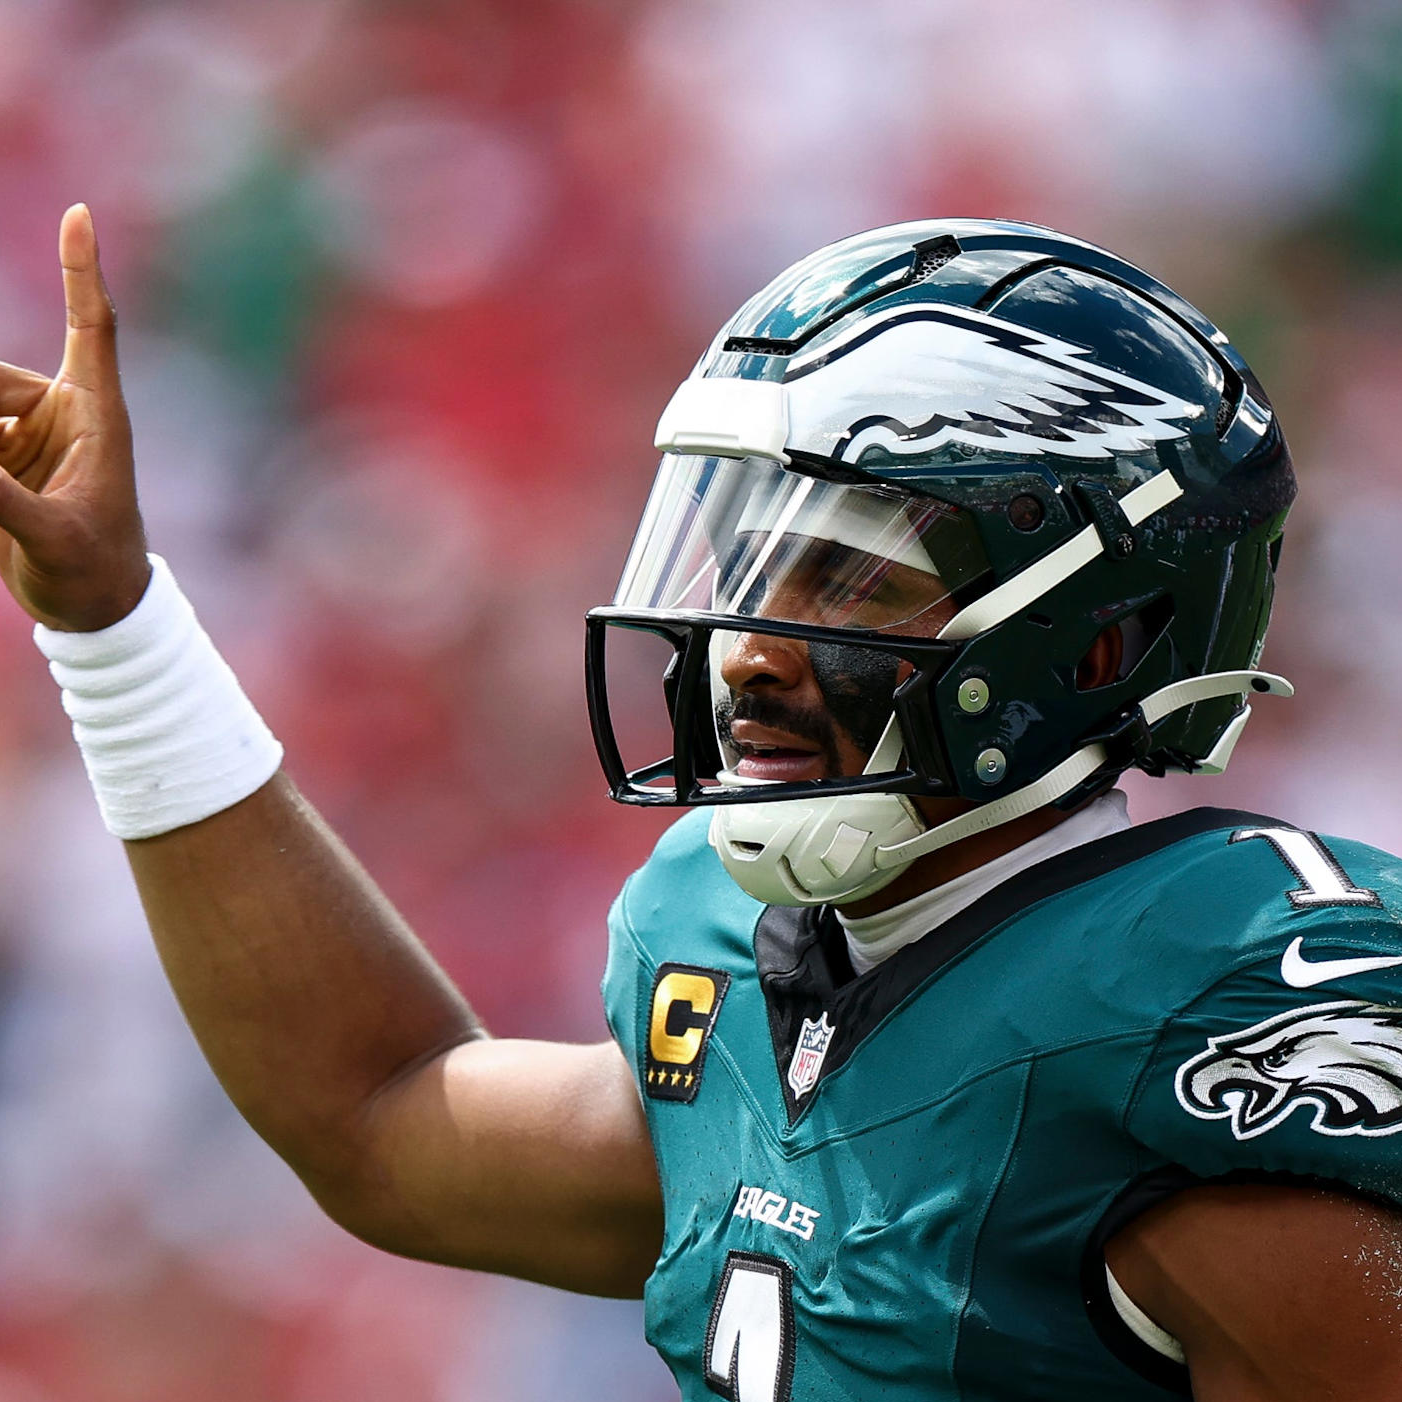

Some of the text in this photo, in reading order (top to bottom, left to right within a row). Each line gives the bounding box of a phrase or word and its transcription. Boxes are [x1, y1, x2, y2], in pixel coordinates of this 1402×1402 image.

[1228, 826, 1383, 909] 1
[650, 972, 716, 1065] C
[795, 1051, 819, 1084] NFL
[733, 1185, 821, 1241] EAGLES
